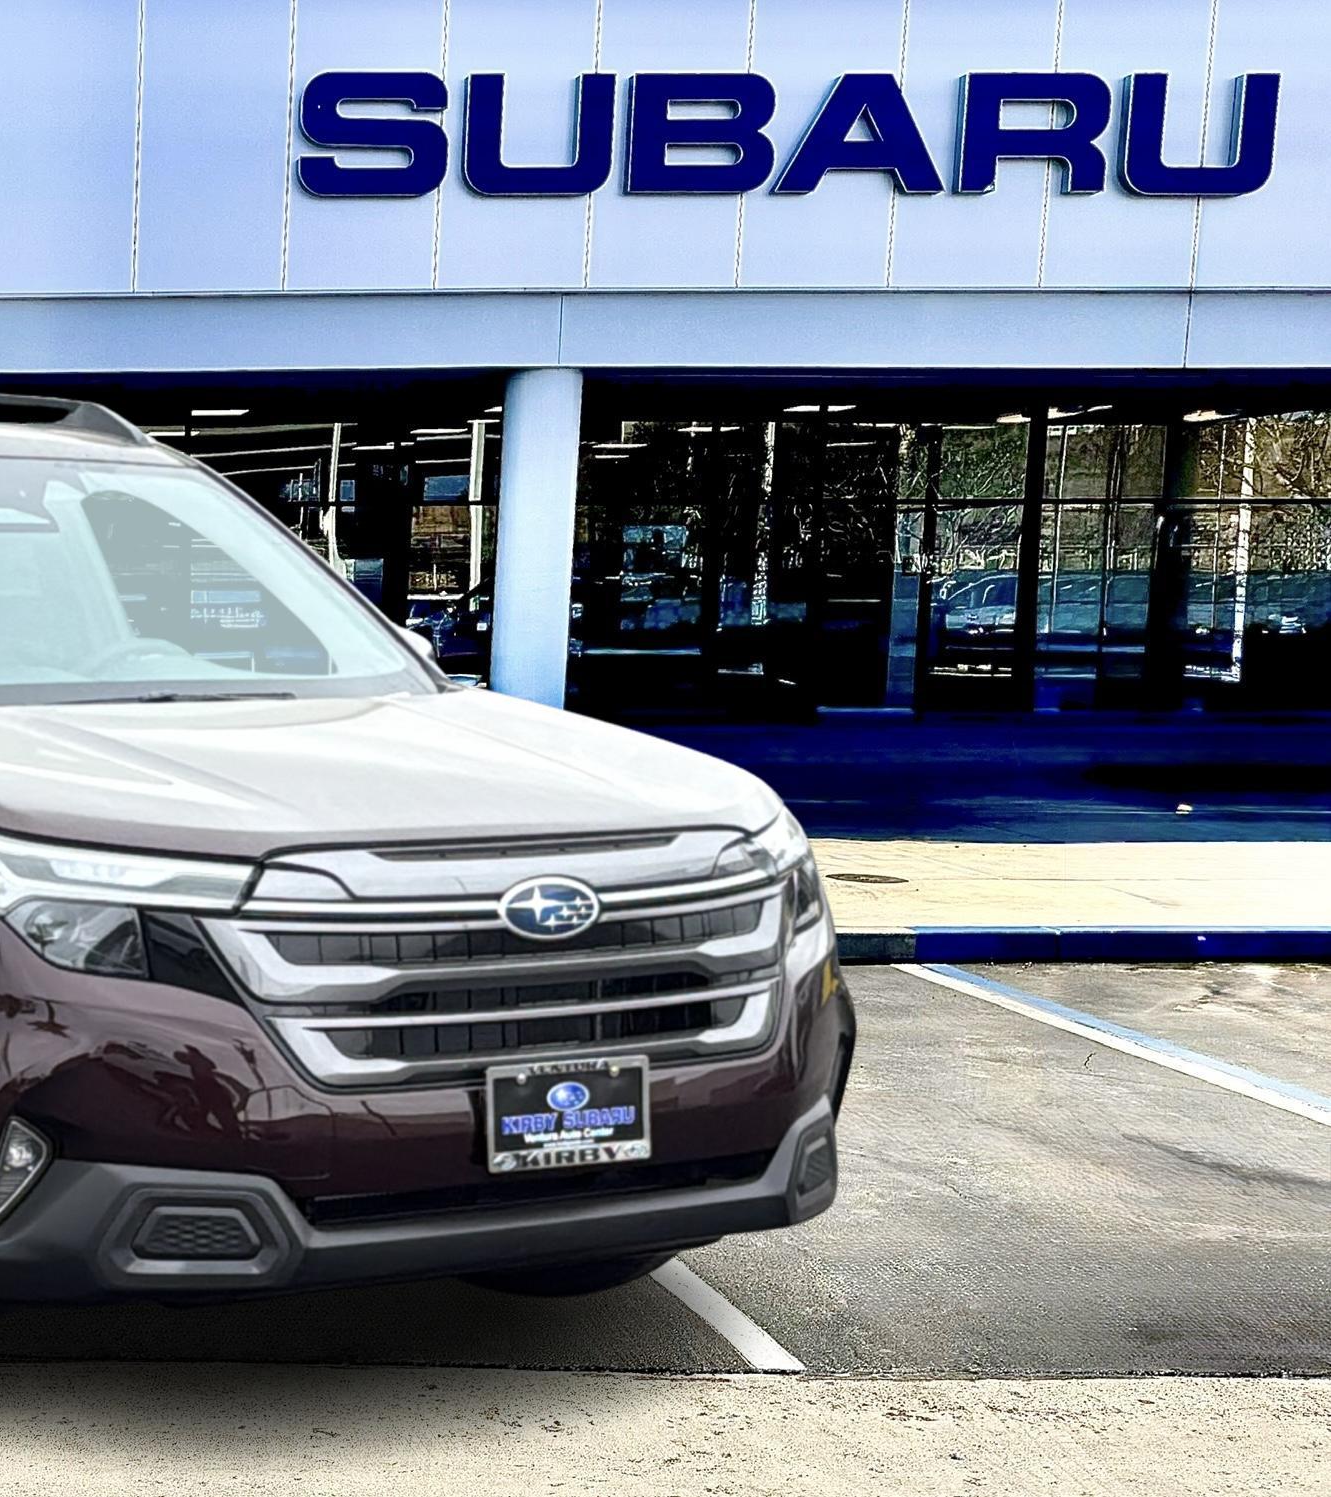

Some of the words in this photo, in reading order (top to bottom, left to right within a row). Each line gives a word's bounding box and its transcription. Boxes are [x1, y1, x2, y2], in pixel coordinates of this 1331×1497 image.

[296, 70, 1281, 198] SUBARU
[502, 1113, 557, 1134] KIRBY
[563, 1106, 635, 1128] SUBARU
[560, 1129, 582, 1140] Auto
[583, 1127, 614, 1138] Center
[521, 1146, 621, 1167] KIRBY
